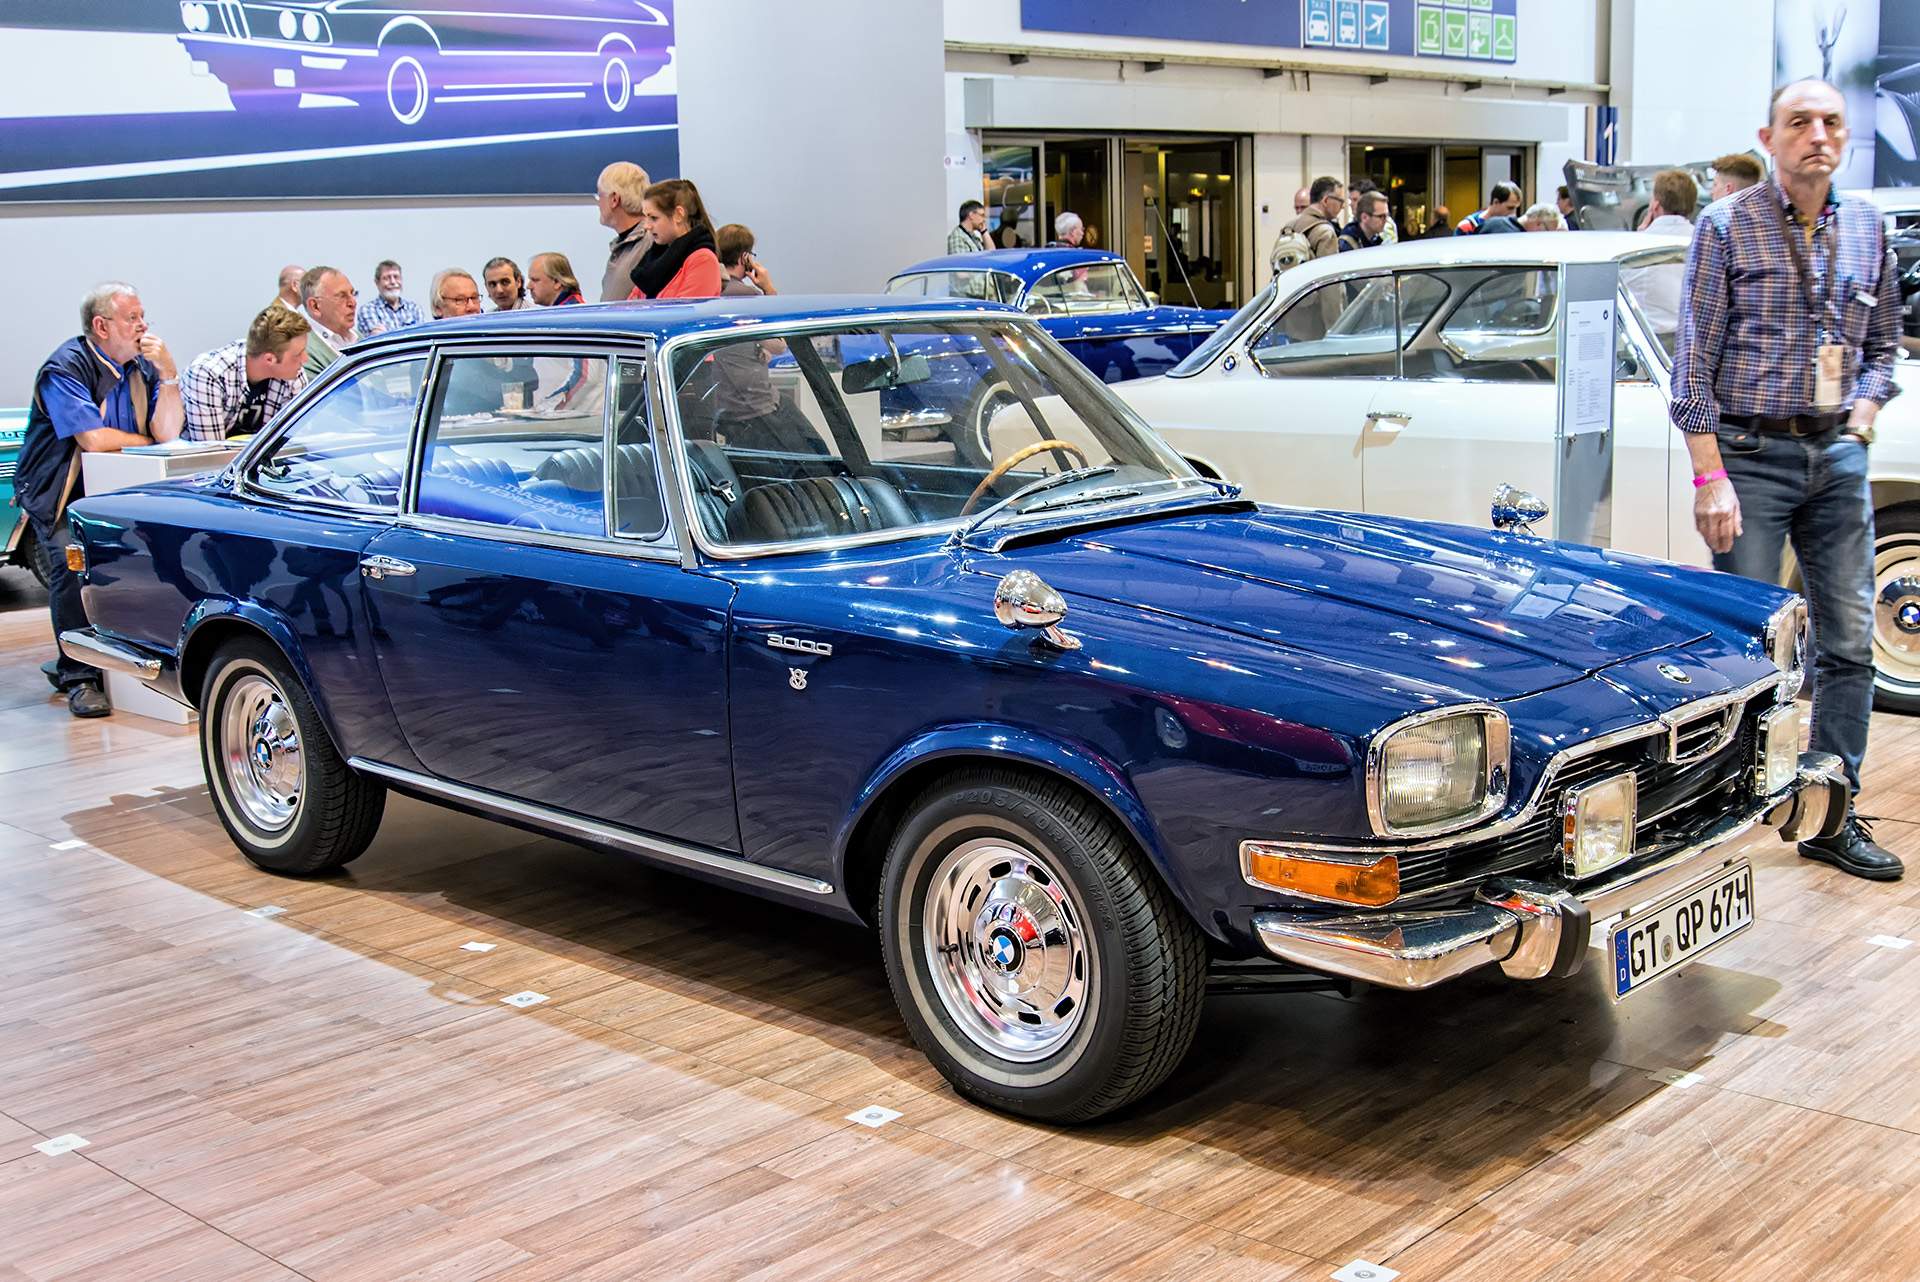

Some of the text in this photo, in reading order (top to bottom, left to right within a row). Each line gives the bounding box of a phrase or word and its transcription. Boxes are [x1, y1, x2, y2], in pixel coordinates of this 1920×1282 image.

[767, 633, 832, 656] 3000
[1630, 873, 1750, 978] GT QP 67H
[1620, 967, 1627, 982] D
